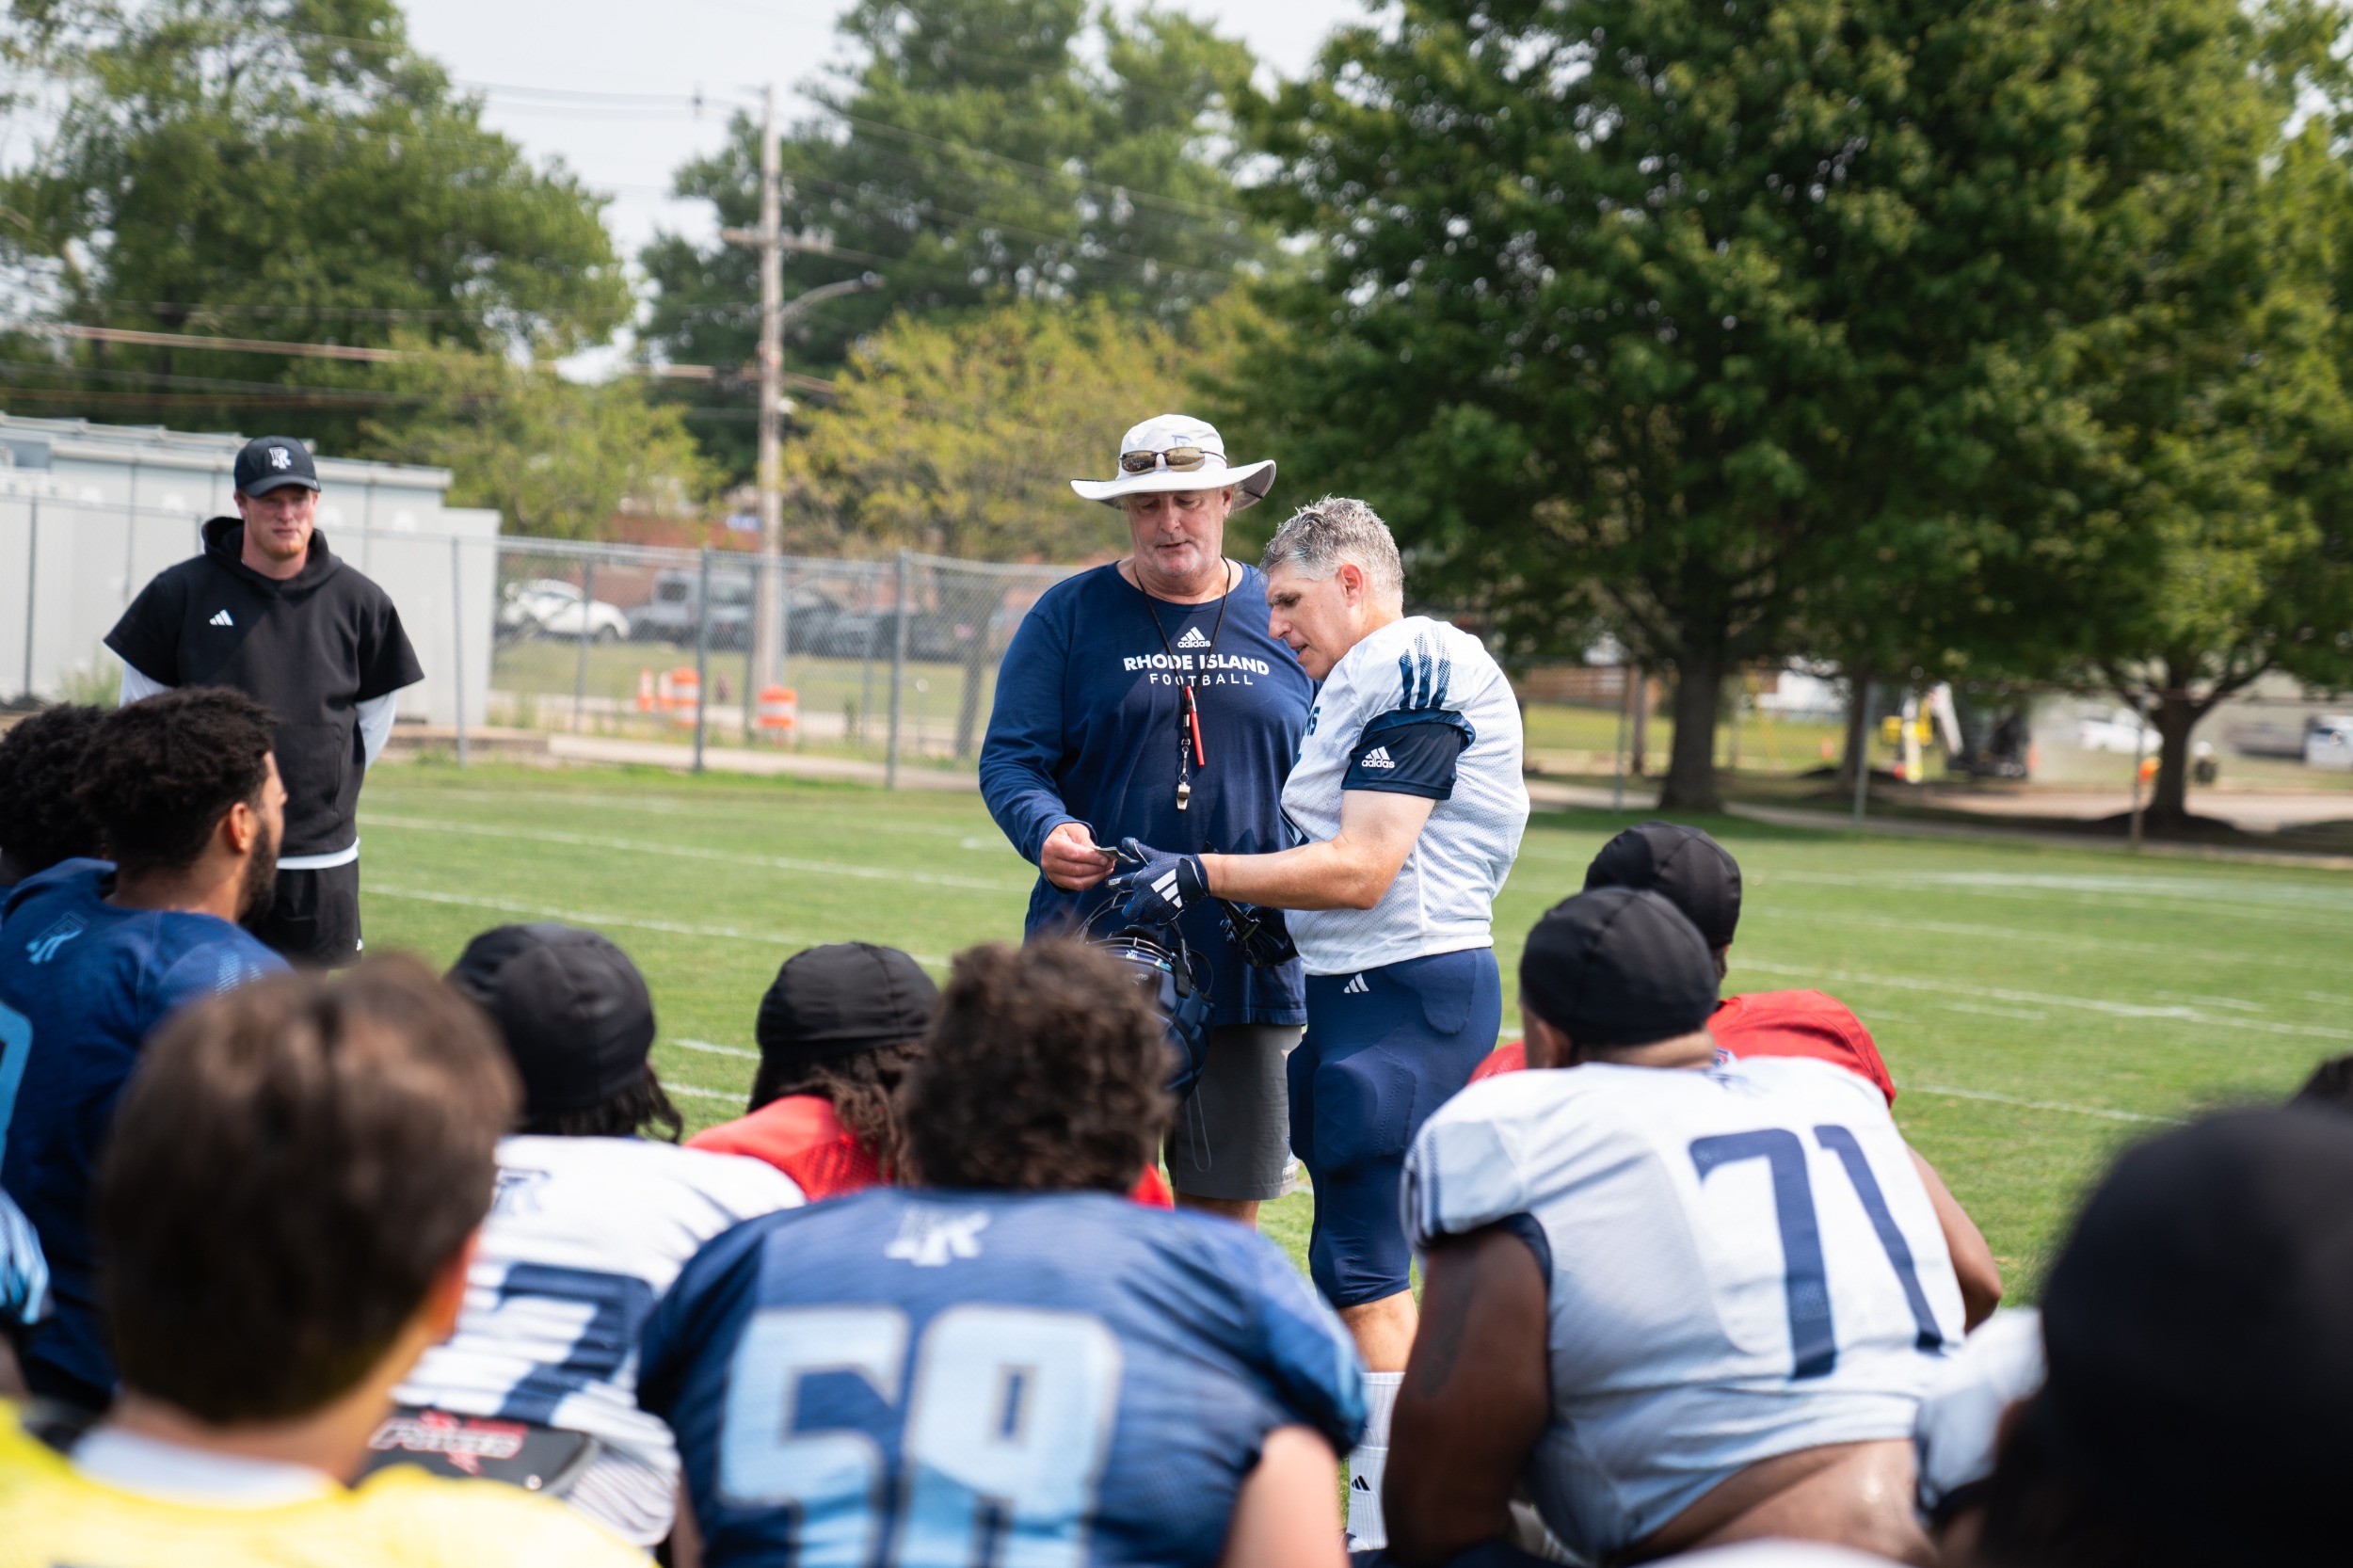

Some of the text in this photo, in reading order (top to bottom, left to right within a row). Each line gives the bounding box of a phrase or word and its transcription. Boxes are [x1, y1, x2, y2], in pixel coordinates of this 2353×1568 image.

[1177, 639, 1211, 648] adidas
[1123, 653, 1270, 676] RHODE ISLAND
[1149, 673, 1254, 687] FOOTBALL
[1361, 758, 1396, 769] adidas
[1689, 1124, 1947, 1382] 71
